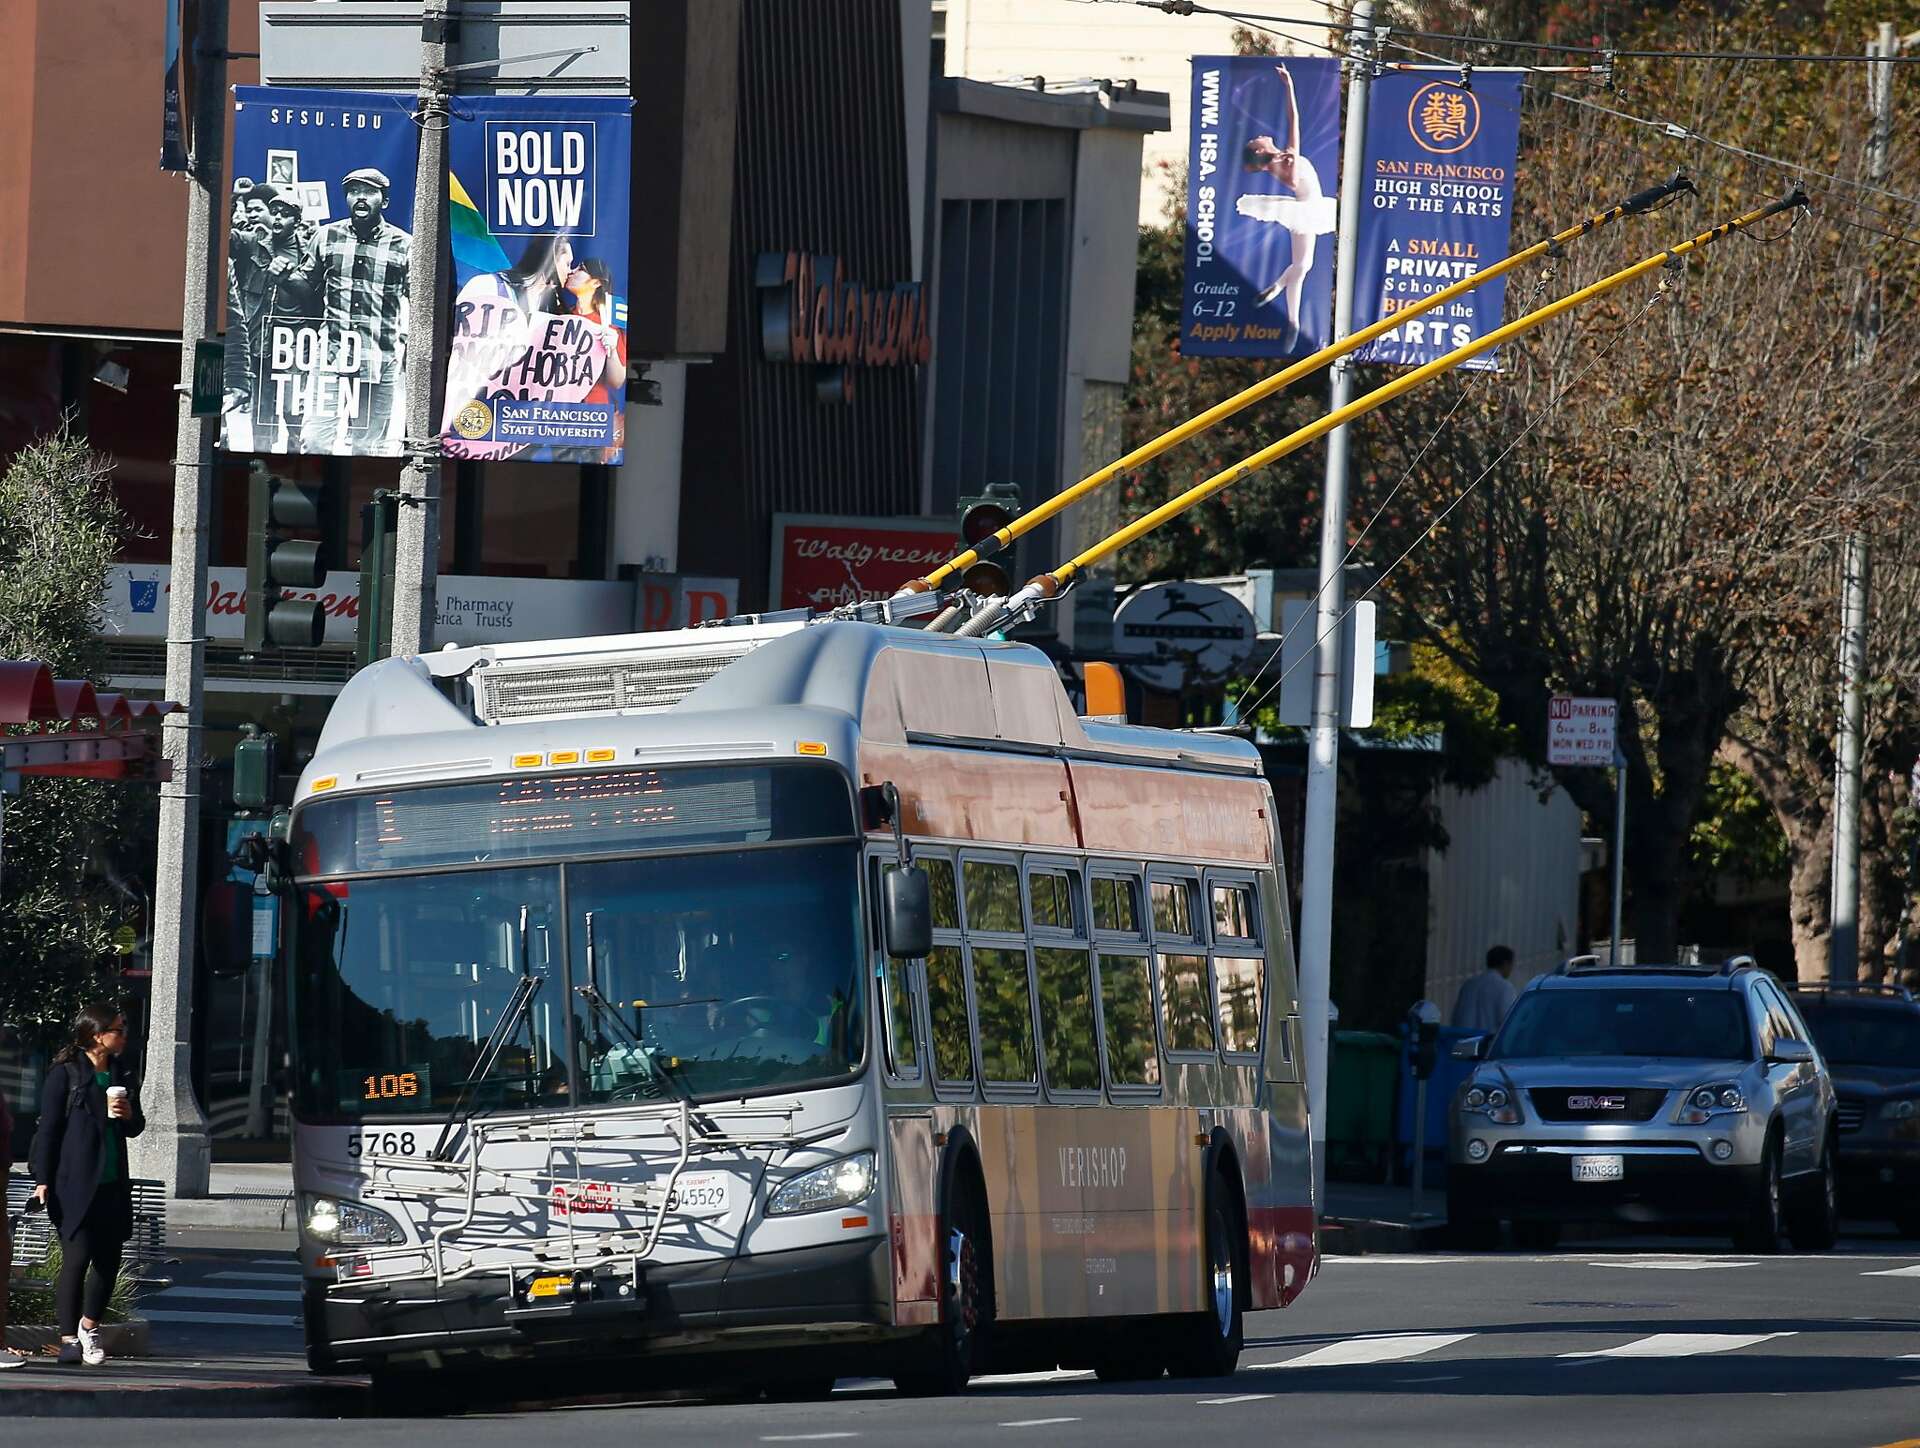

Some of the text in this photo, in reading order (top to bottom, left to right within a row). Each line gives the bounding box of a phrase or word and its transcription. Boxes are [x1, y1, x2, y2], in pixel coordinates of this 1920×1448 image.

[271, 109, 382, 129] SFSU.EDU
[496, 130, 585, 175] BOLD
[1376, 160, 1505, 180] SAN FRANCISCO
[1374, 179, 1504, 201] HIGH SCHOOL
[498, 178, 584, 227] NOW
[1373, 196, 1502, 217] OF THE ARTS
[1387, 239, 1479, 259] A SMALL
[1385, 257, 1478, 279] PRIVATE
[1193, 282, 1239, 296] Grades
[1384, 276, 1450, 294] Schoo
[1451, 301, 1474, 318] the
[543, 319, 593, 355] END
[1190, 322, 1281, 342] Apply Now
[1379, 320, 1472, 348] ARTS
[271, 326, 362, 373] BOLD
[270, 373, 361, 419] THEN
[446, 596, 514, 616] Pharmacy
[475, 612, 513, 628] Trusts
[1551, 700, 1617, 718] NO PARKING
[1553, 738, 1572, 749] MON
[1576, 739, 1594, 750] WED
[364, 1073, 417, 1099] 106
[1568, 1095, 1625, 1109] GMC
[347, 1131, 416, 1158] 5768
[1057, 1146, 1127, 1189] VERISHOP
